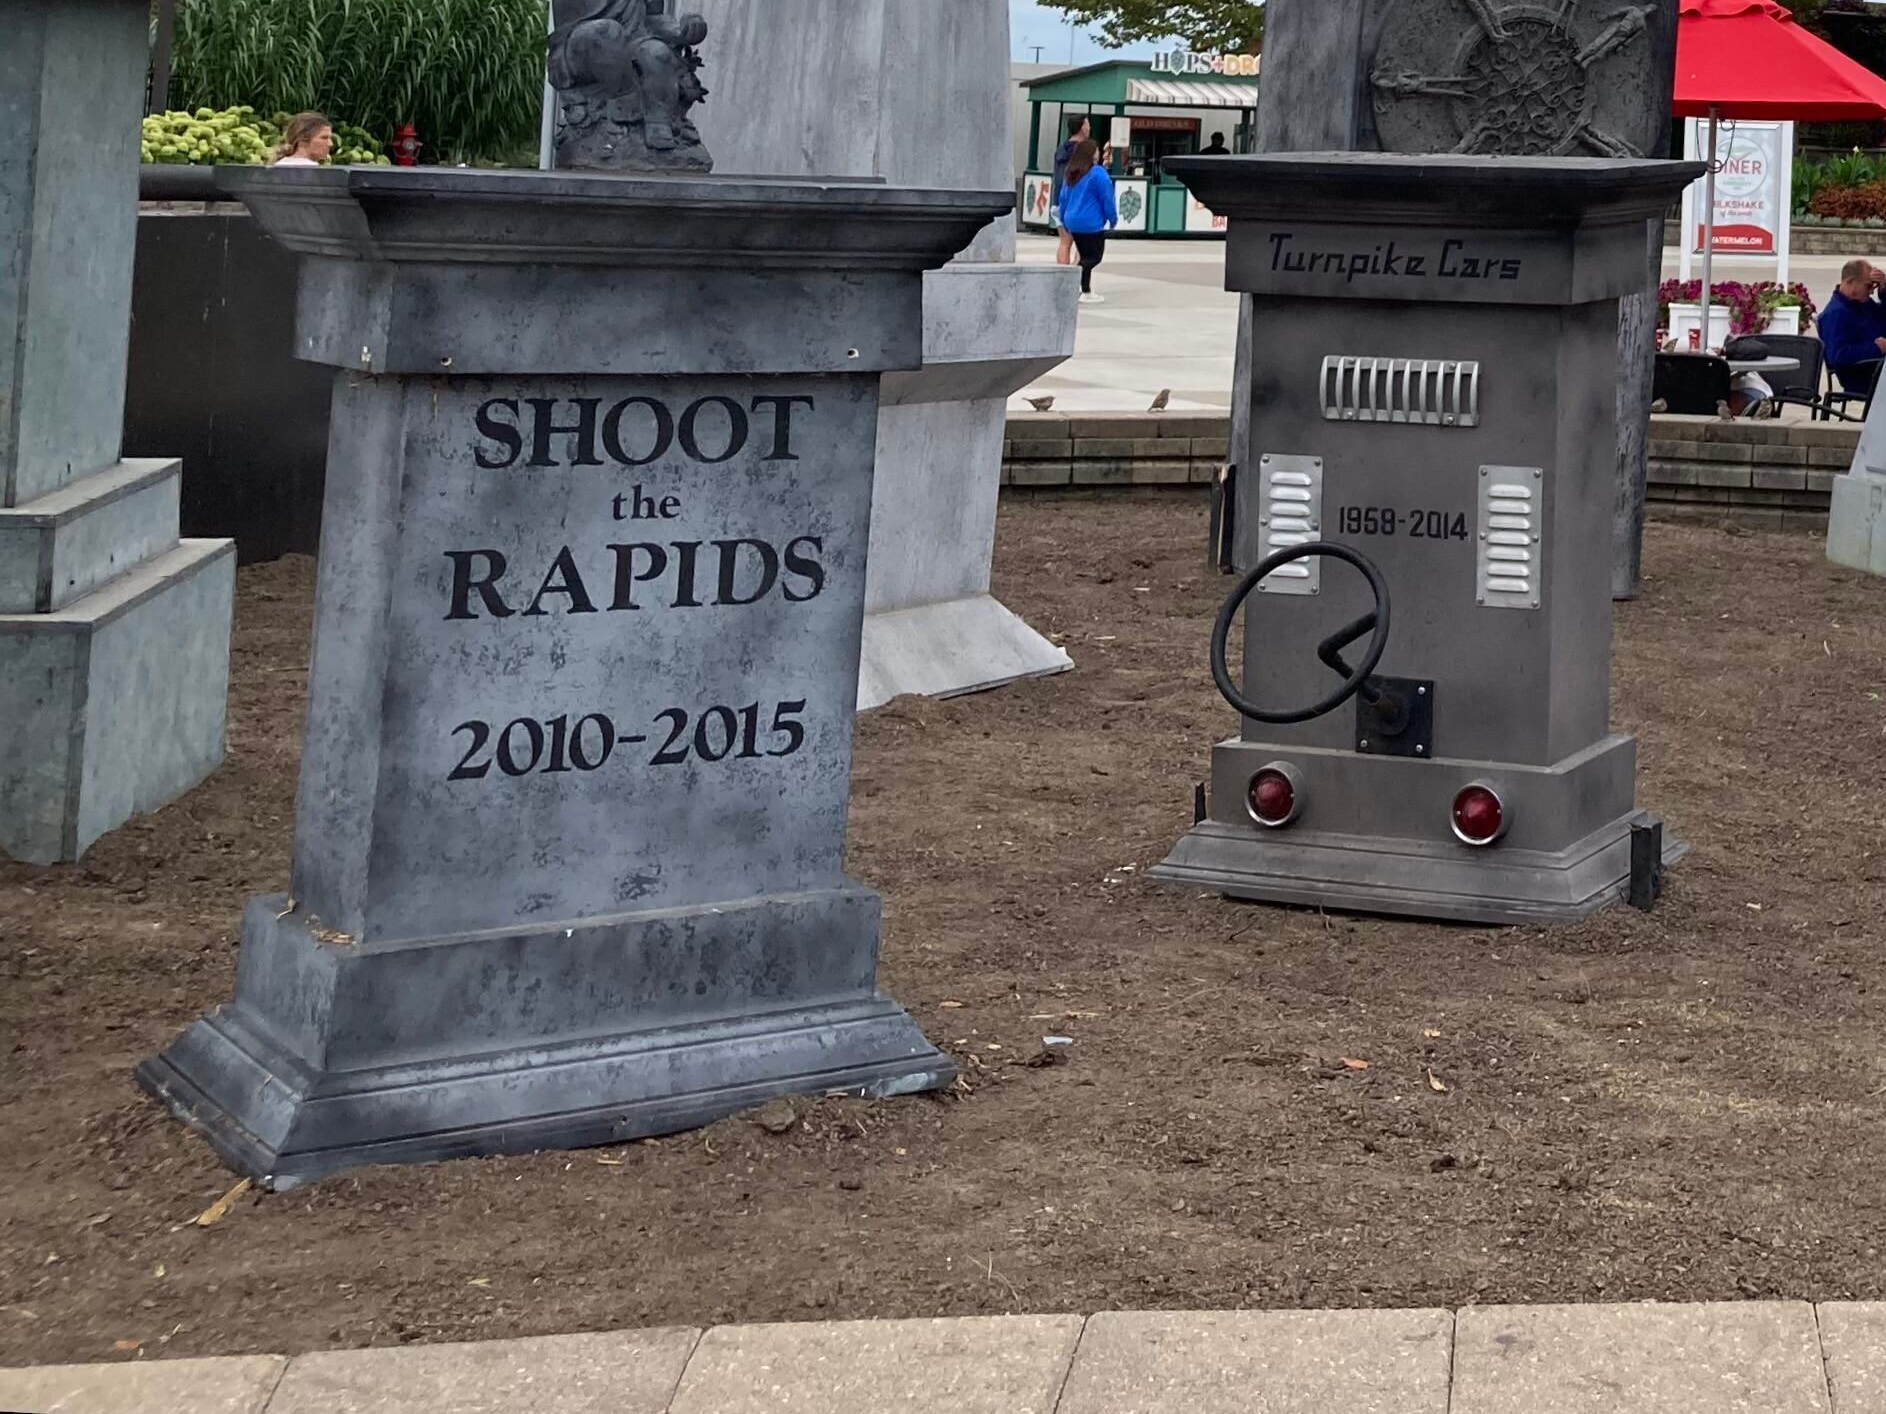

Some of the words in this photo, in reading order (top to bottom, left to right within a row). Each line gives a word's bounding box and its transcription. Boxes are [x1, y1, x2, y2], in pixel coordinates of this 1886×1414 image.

[1721, 159, 1762, 175] INER
[1713, 199, 1765, 210] ILKSHAKE
[1269, 232, 1426, 282] Turnpike
[1437, 238, 1522, 280] Cars
[473, 394, 816, 470] SHOOT
[610, 484, 682, 521] the
[442, 535, 826, 621] RAPIDS
[447, 698, 806, 782] 2010-2015
